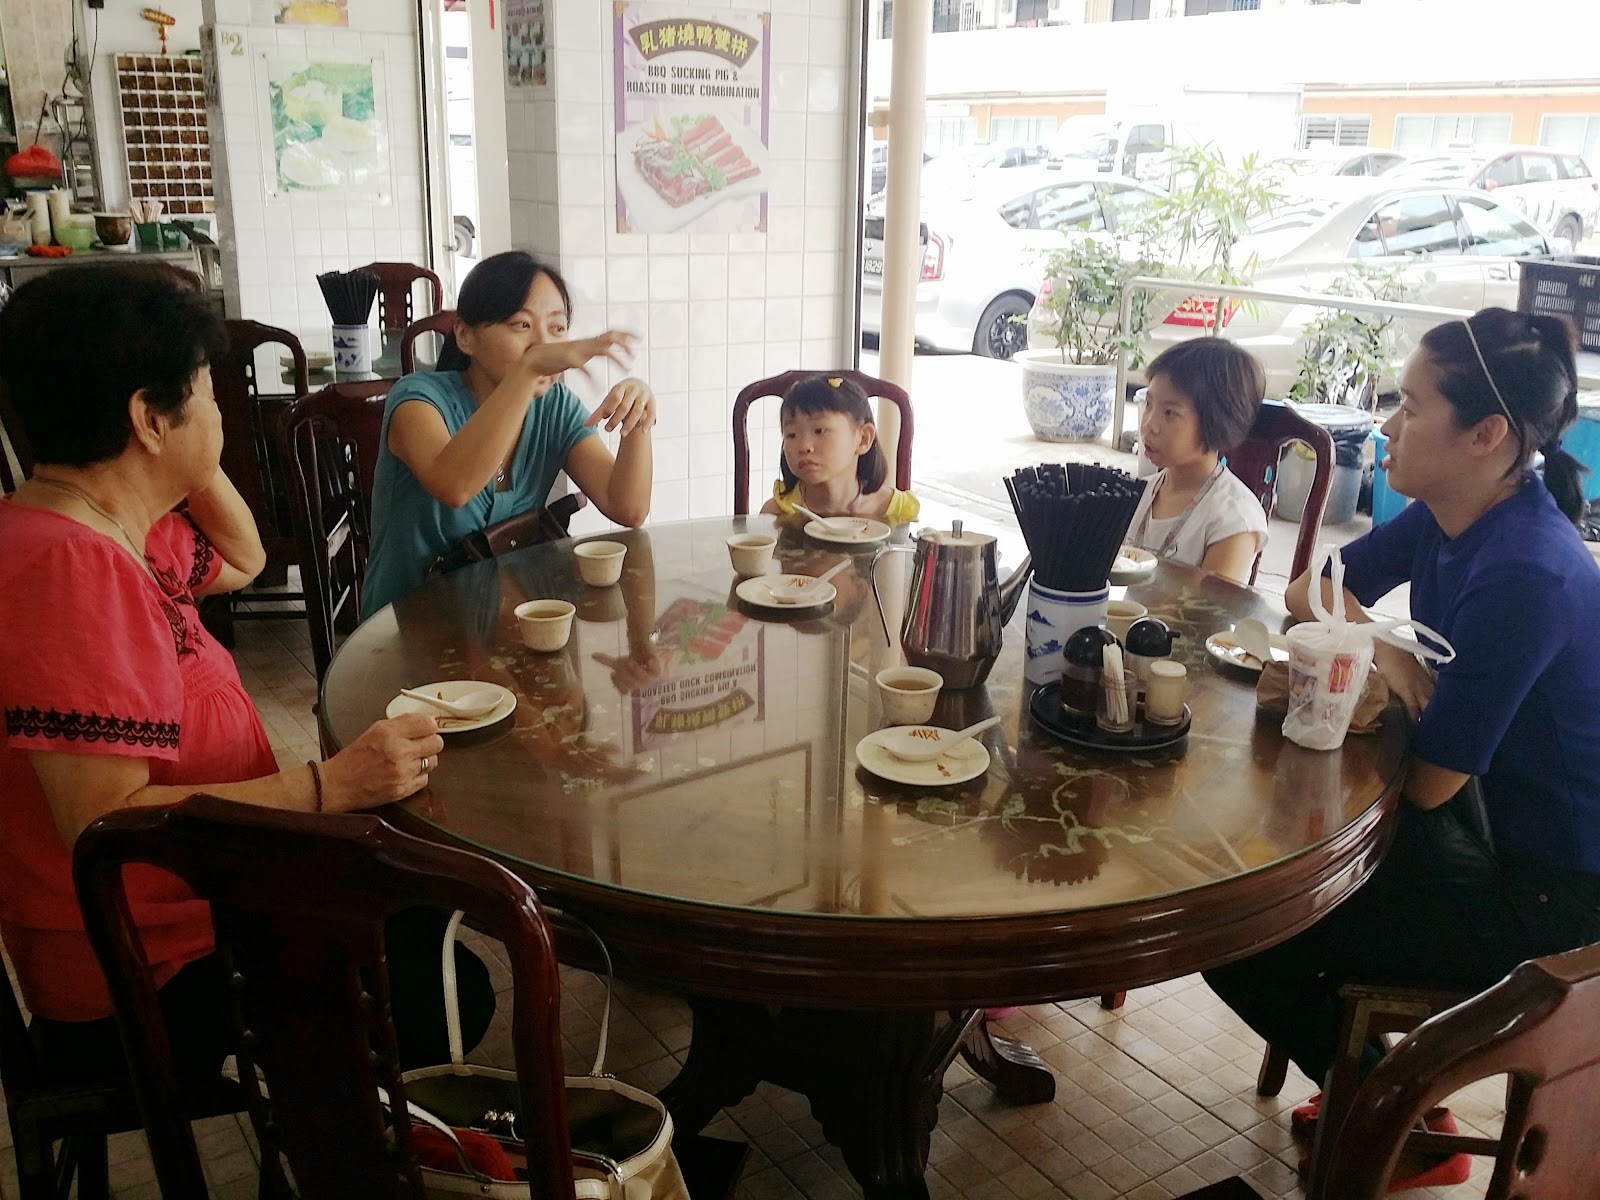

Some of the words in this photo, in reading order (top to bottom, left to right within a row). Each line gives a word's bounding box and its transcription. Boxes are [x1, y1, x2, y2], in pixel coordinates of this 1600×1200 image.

[648, 65, 667, 78] BBQ
[671, 68, 711, 80] SUCKING
[715, 70, 729, 80] PIG
[732, 71, 738, 81] &
[626, 81, 667, 94] ROASTED
[671, 84, 695, 96] DUCK
[700, 85, 760, 99] COMBINATION
